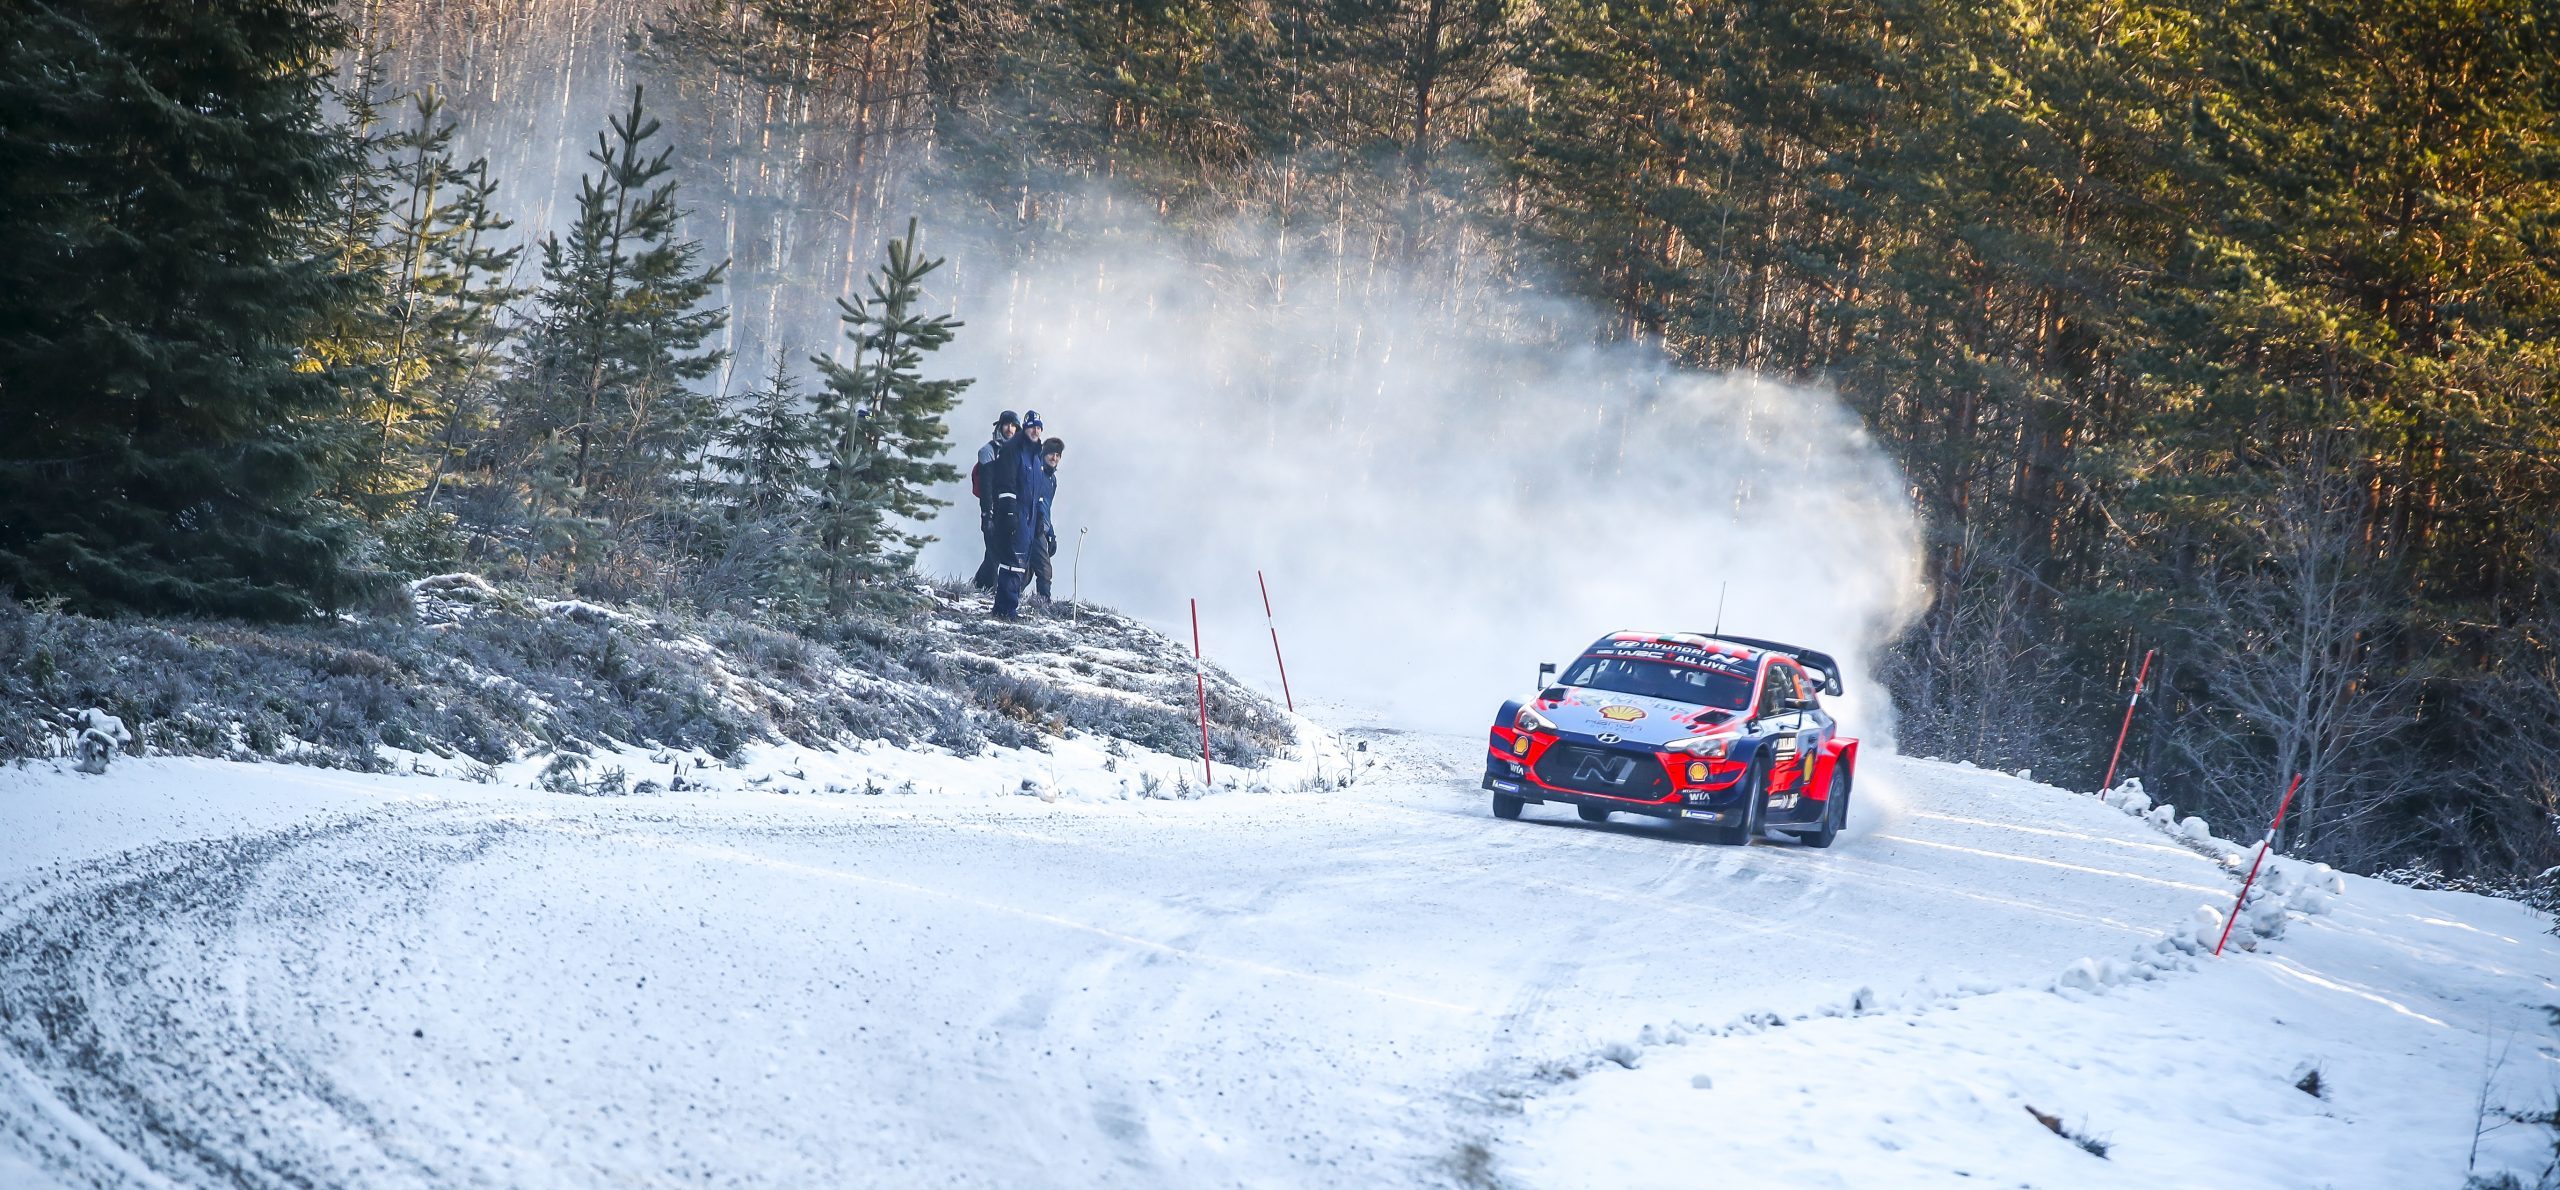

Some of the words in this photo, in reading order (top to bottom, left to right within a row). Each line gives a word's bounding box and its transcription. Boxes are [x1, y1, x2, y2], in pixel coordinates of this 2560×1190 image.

[1617, 649, 1665, 659] WRC
[1674, 655, 1698, 664] ALL
[1700, 659, 1727, 671] LIVE
[1642, 642, 1706, 656] HYUNDAI
[1572, 754, 1637, 785] N
